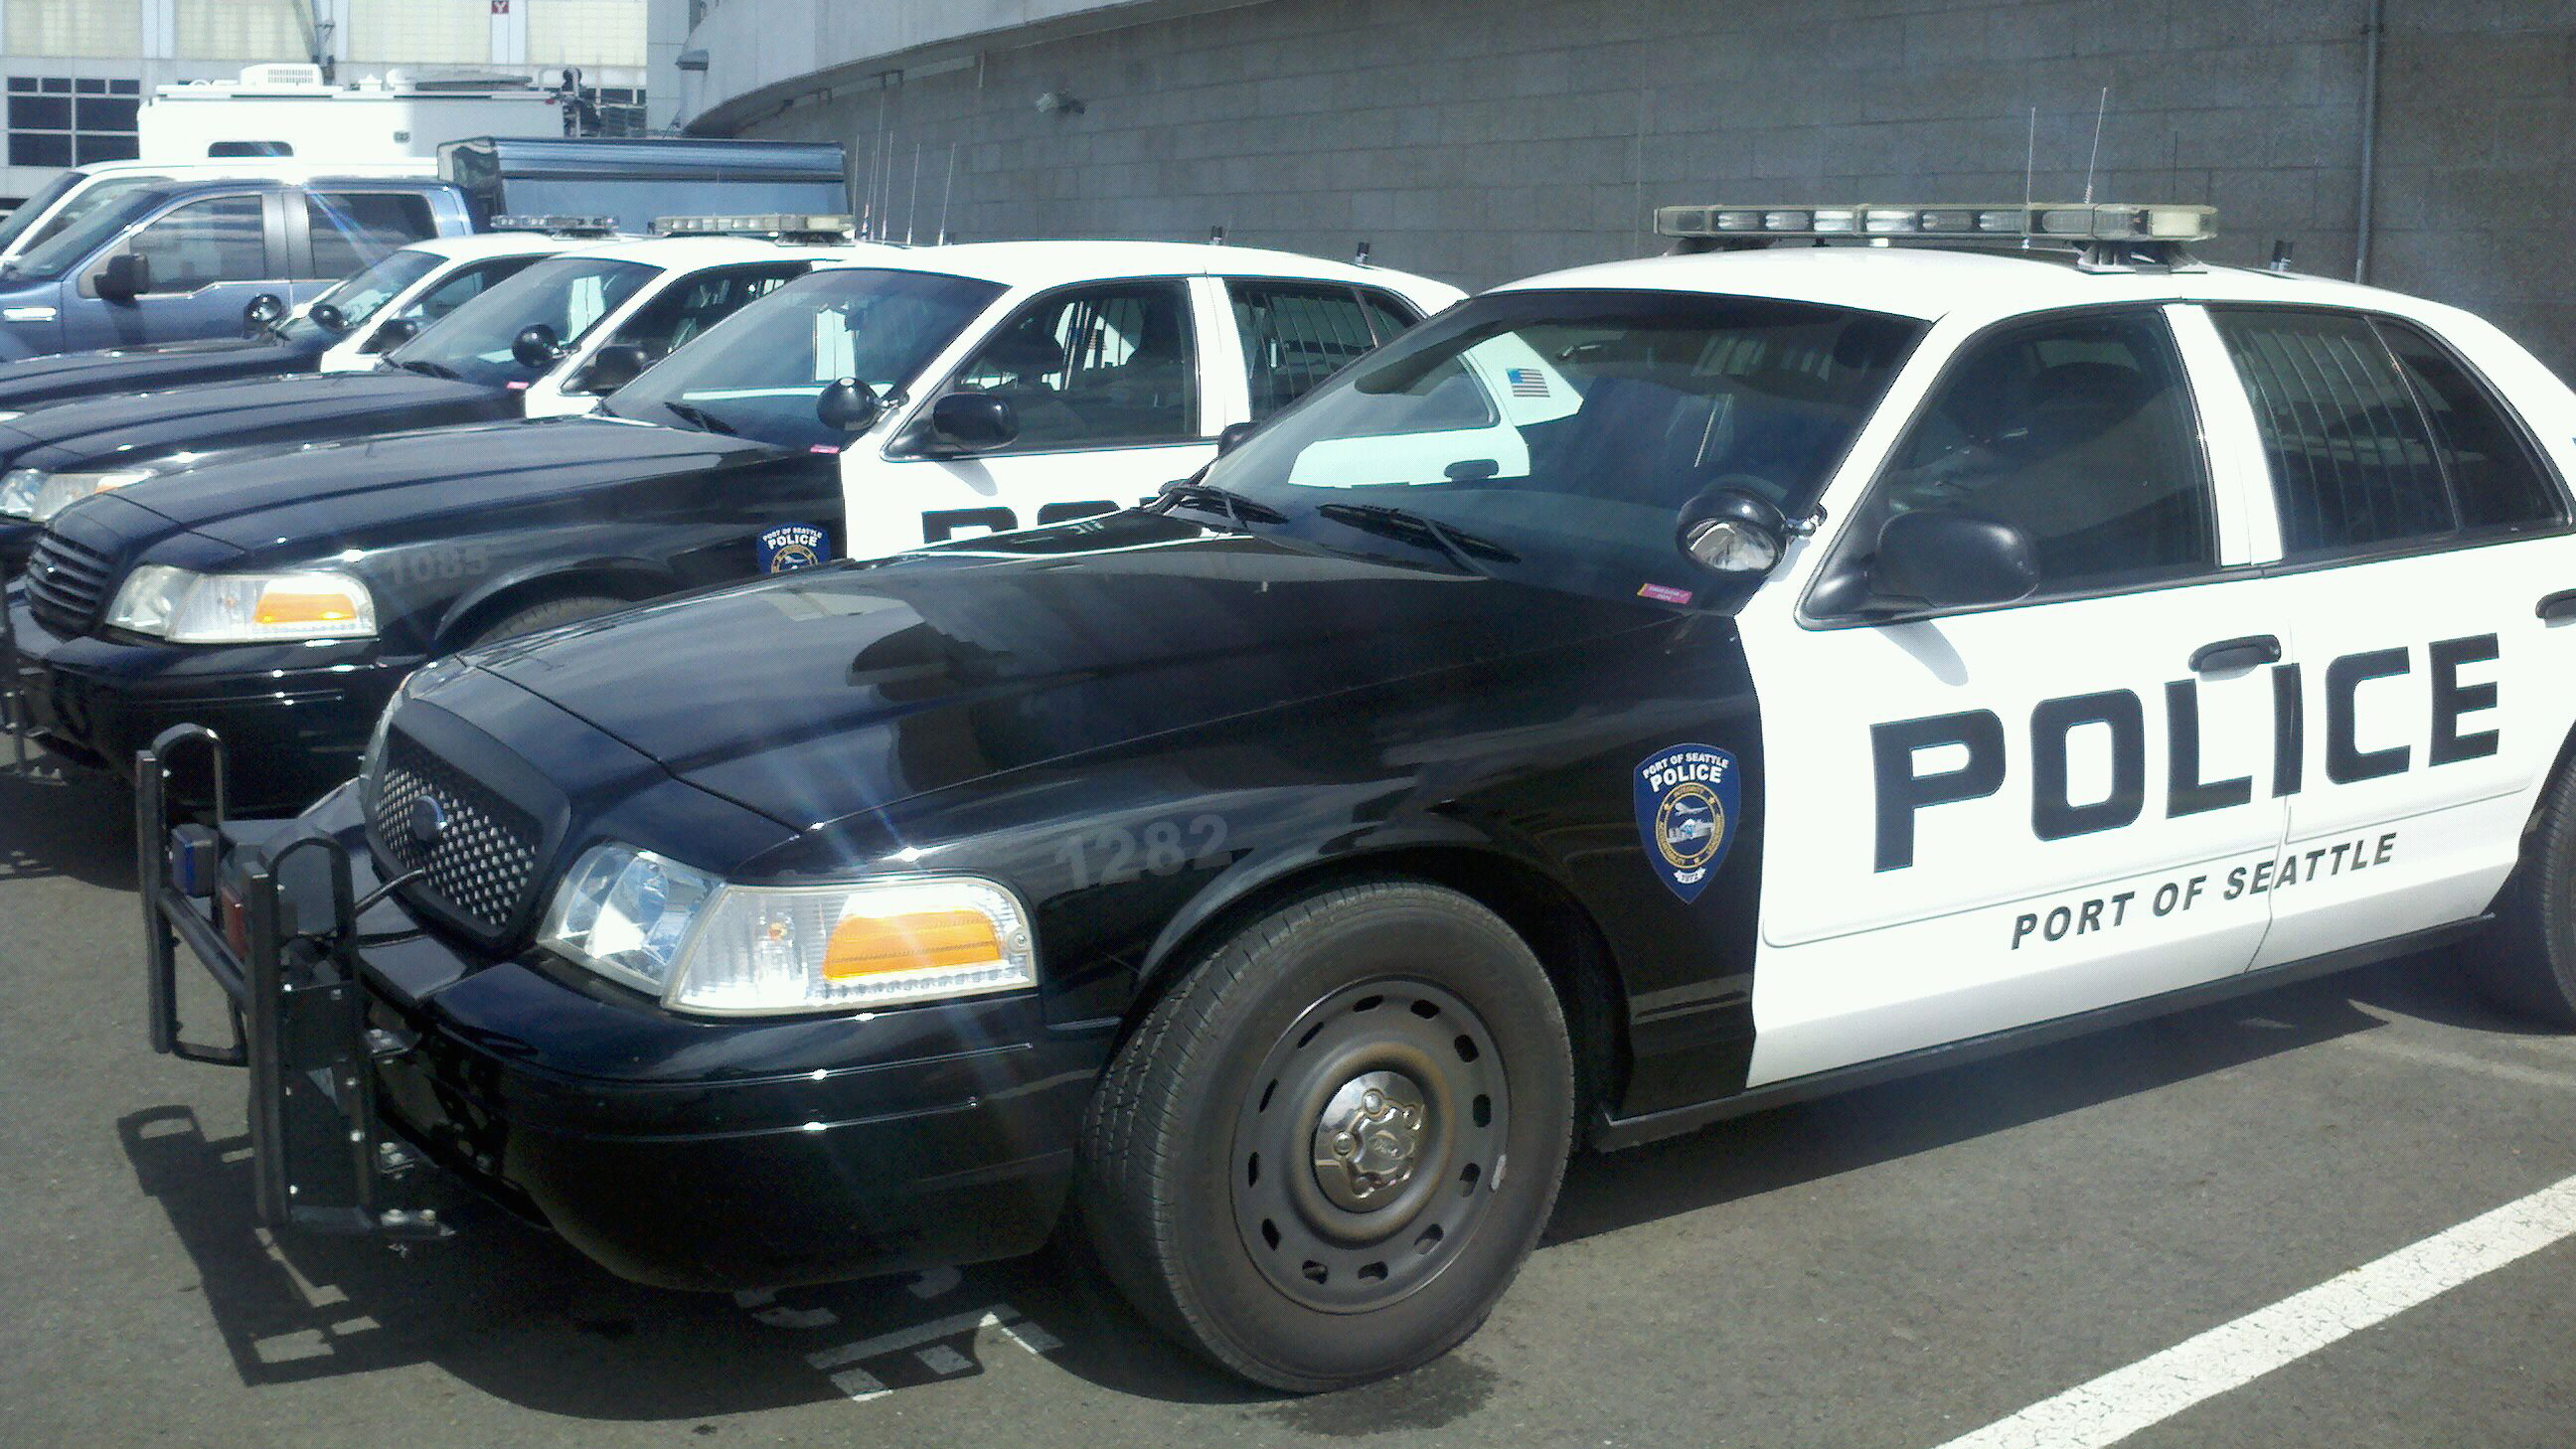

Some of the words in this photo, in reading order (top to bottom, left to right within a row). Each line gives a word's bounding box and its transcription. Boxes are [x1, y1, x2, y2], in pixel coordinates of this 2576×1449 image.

[767, 535, 818, 550] POLICE
[1642, 758, 1668, 779] PORT
[1670, 753, 1684, 765] OF
[1686, 752, 1729, 768] SEATTLE
[1650, 763, 1722, 792] POLICE
[1870, 633, 2498, 874] POLICE
[1054, 814, 1230, 889] 1282
[2012, 890, 2135, 950] PORT
[2152, 876, 2206, 917] OF
[2222, 832, 2397, 900] SEATTLE
